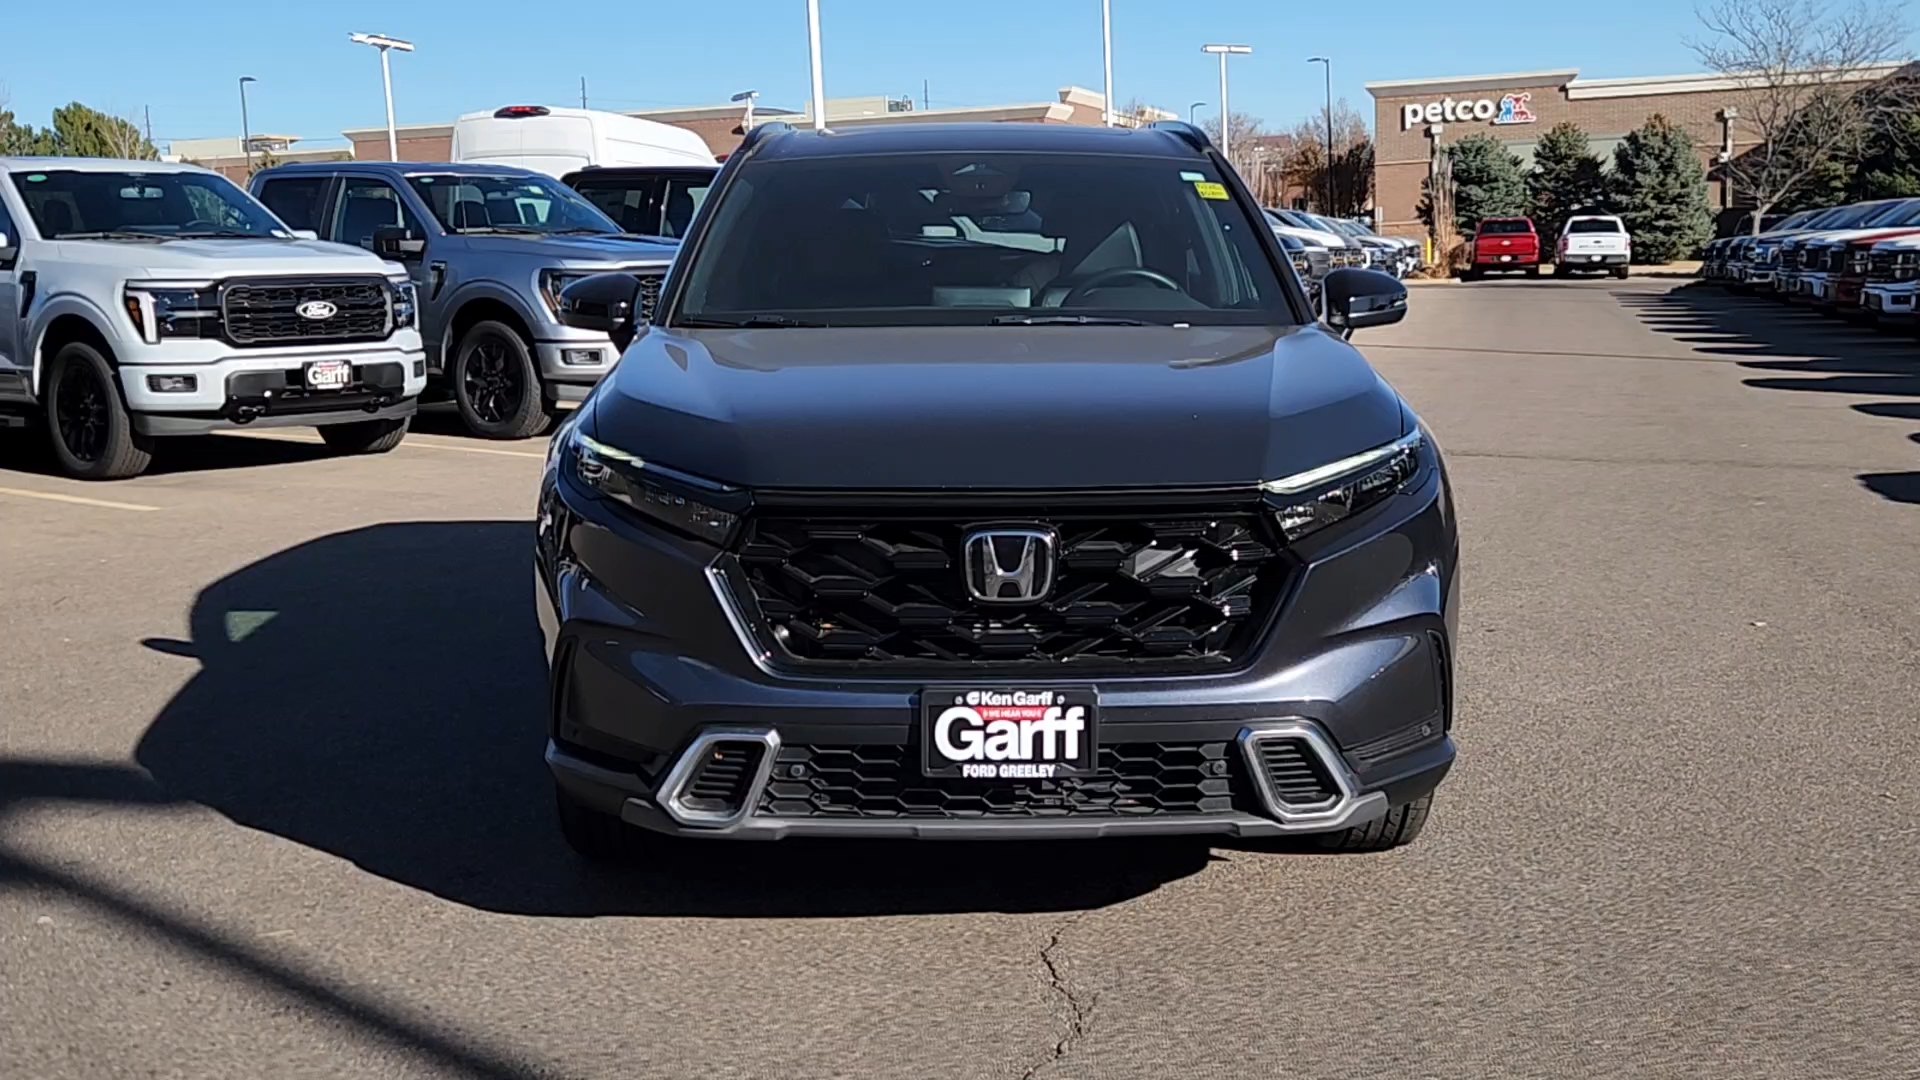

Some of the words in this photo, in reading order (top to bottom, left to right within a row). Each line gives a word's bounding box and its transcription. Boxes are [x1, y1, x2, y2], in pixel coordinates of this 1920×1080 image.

[1404, 97, 1495, 130] petco
[308, 364, 349, 384] Garff
[981, 691, 1012, 705] Ken
[1013, 691, 1053, 706] Garff
[934, 706, 1085, 761] Garff
[962, 764, 997, 777] FORD
[999, 764, 1056, 777] GREELEY
